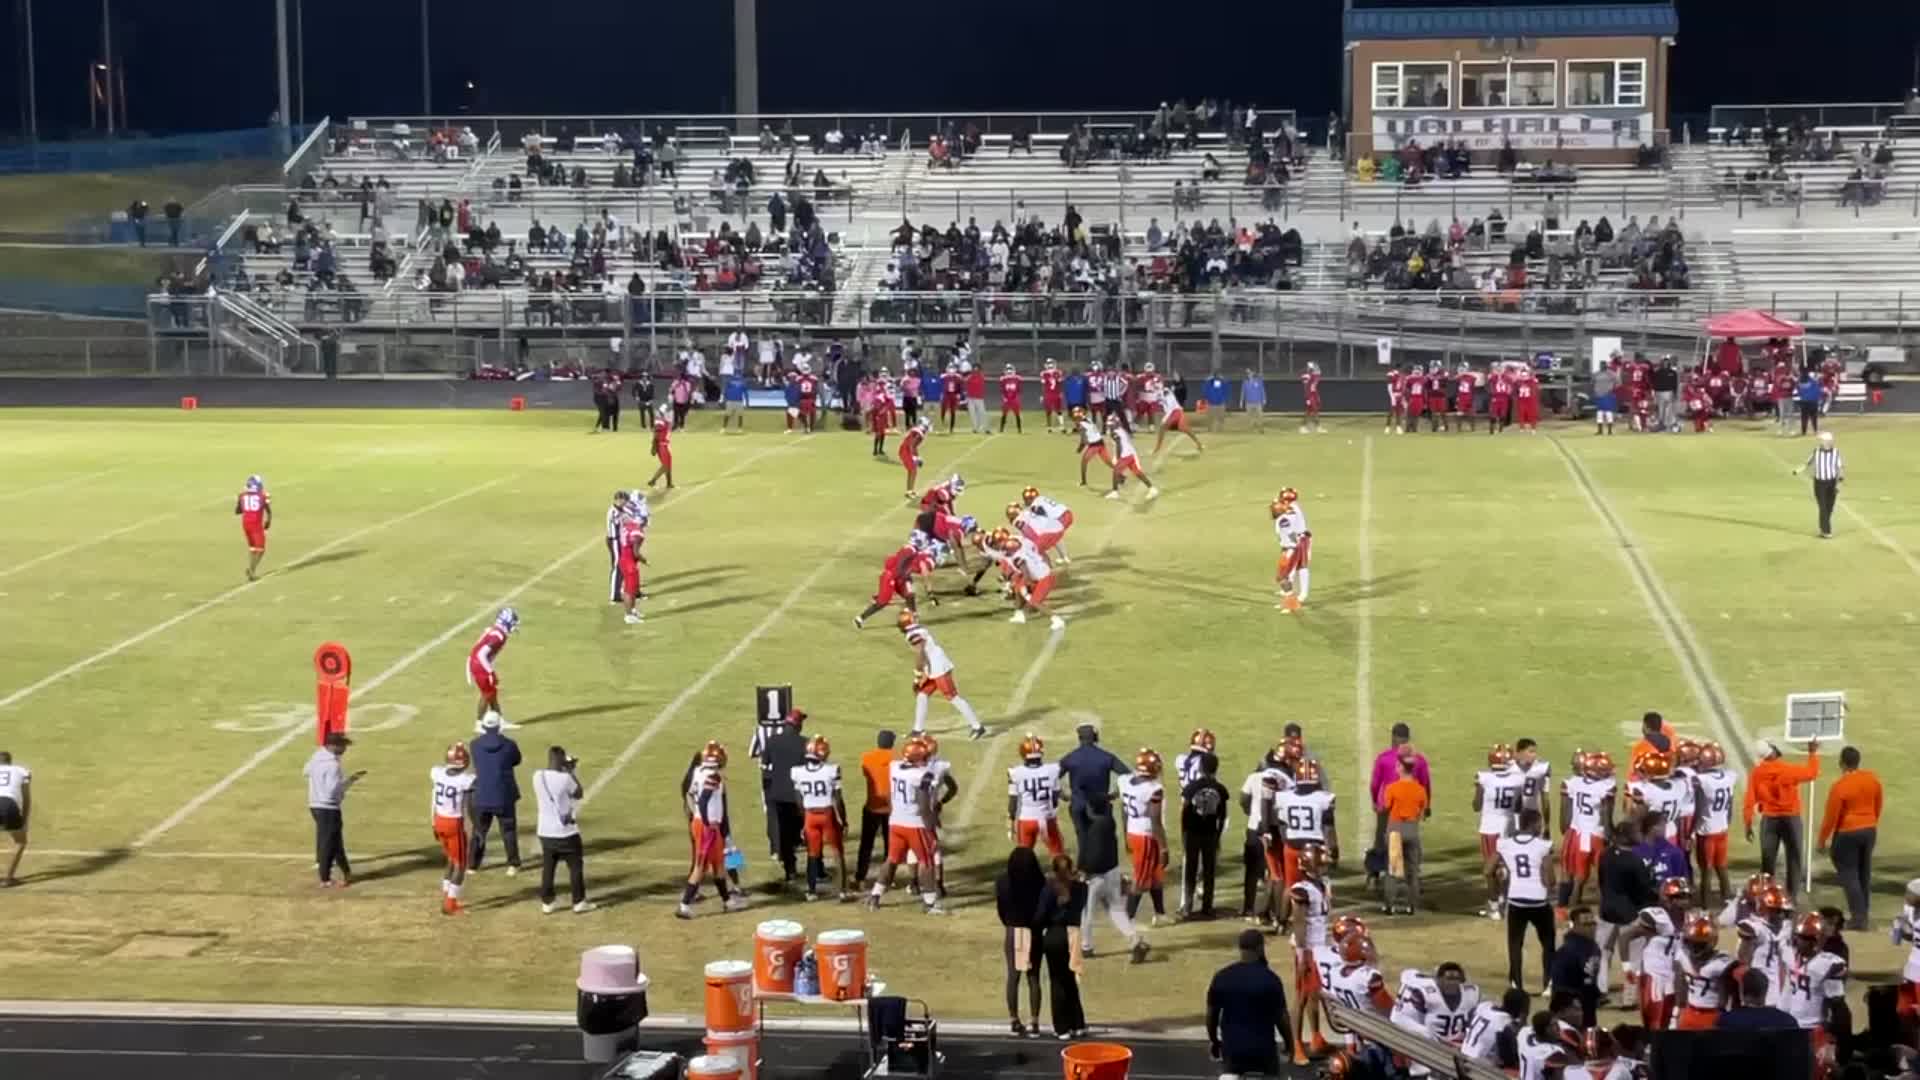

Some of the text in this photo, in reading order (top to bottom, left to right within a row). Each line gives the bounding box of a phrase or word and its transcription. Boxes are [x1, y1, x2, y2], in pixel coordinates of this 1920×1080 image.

[244, 495, 261, 511] 16
[767, 689, 781, 720] 1
[435, 782, 457, 809] 29
[1024, 777, 1050, 801] 45
[1524, 777, 1537, 797] 8
[1576, 791, 1594, 816] 15
[1288, 805, 1314, 830] 63
[1515, 854, 1531, 878] 8
[769, 949, 785, 966] G
[833, 954, 849, 971] G
[1435, 1014, 1466, 1036] 30
